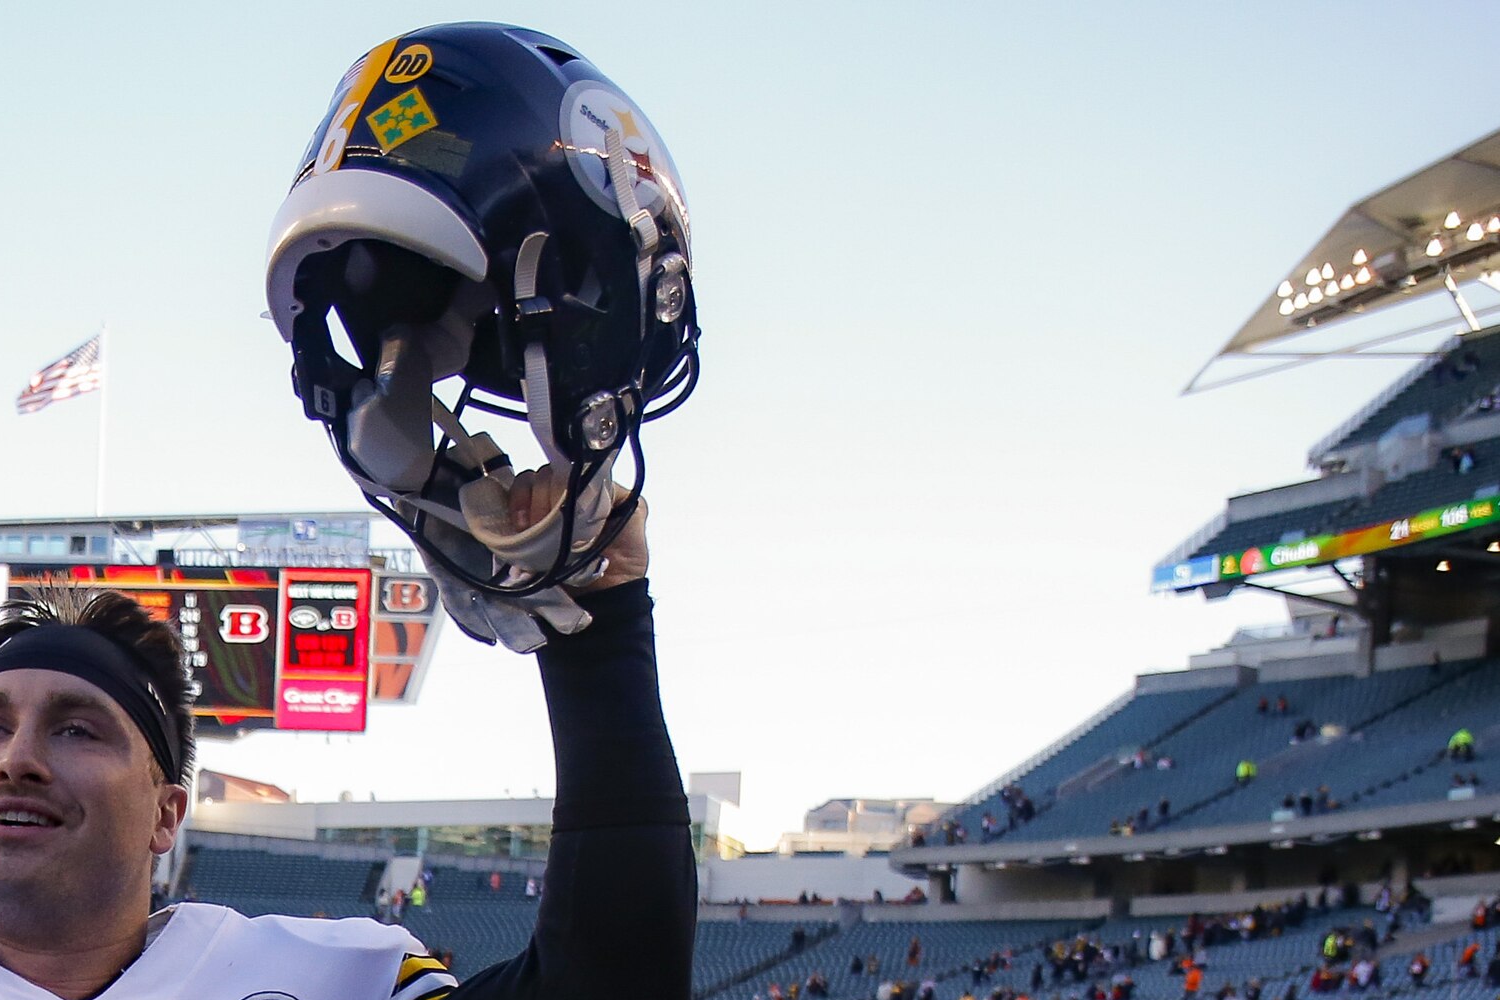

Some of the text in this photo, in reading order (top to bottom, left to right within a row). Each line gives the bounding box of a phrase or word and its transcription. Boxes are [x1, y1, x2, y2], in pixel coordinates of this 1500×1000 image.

[389, 53, 429, 77] DD
[579, 103, 610, 132] Steel
[313, 102, 360, 174] 6
[321, 389, 330, 412] 6
[1270, 542, 1319, 565] Chubb
[382, 578, 430, 613] B
[219, 604, 269, 643] B
